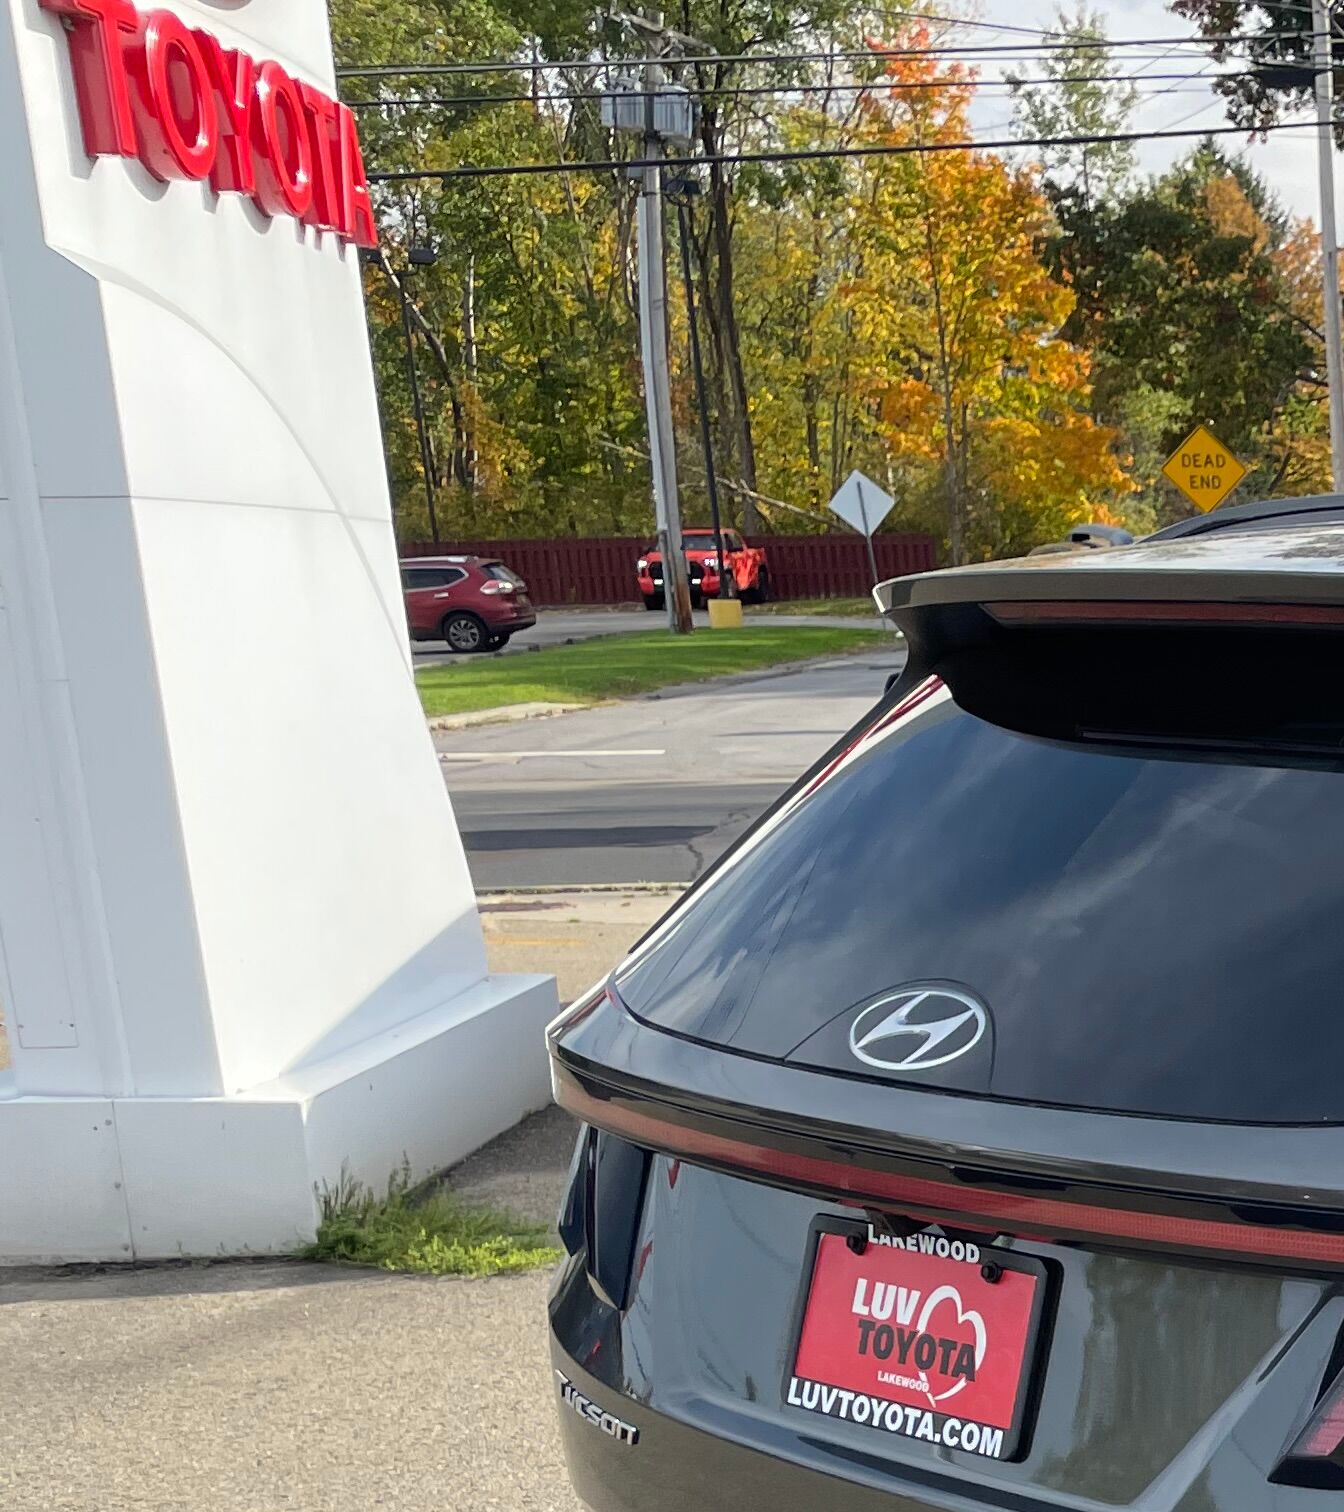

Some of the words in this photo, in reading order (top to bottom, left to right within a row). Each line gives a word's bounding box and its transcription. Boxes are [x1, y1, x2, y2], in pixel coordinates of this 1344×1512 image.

[37, 0, 378, 248] TOYOTA
[1181, 453, 1226, 468] DEAD
[1189, 475, 1221, 490] END
[852, 1277, 921, 1325] LUV
[858, 1319, 976, 1382] TOYOTA
[877, 1371, 929, 1392] LAKEWOOD
[787, 1377, 1004, 1458] LUVTOYOTA.COM
